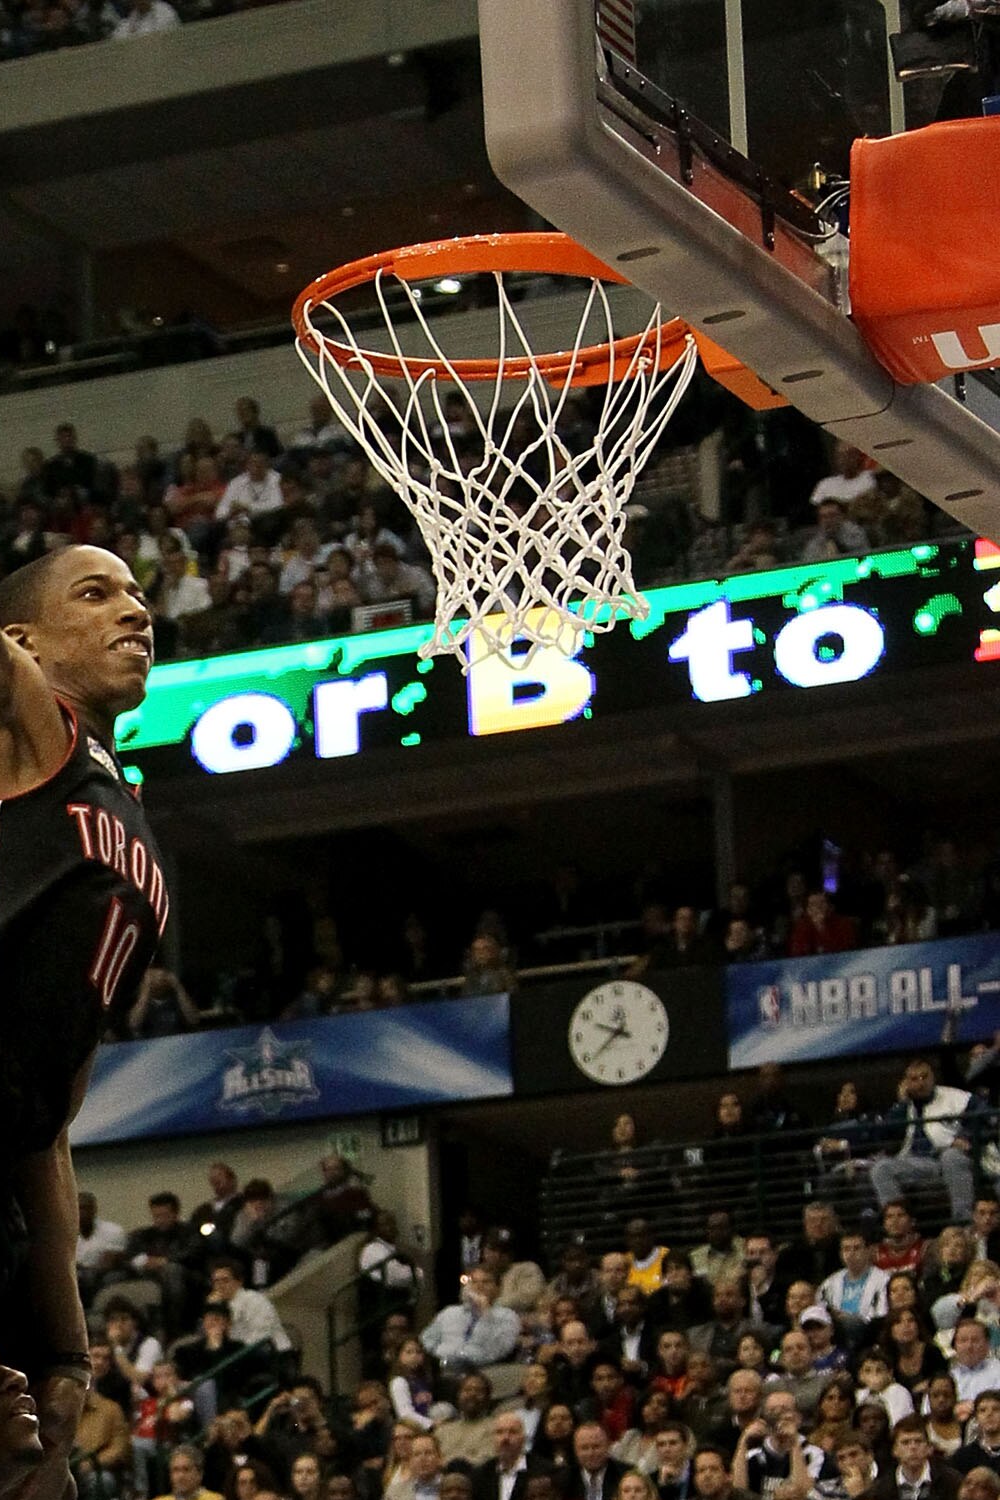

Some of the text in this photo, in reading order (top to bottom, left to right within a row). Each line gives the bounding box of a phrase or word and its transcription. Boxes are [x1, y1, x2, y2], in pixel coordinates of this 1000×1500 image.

[191, 671, 389, 774] or
[467, 605, 597, 737] B
[667, 597, 886, 704] to
[89, 896, 140, 1007] 10
[791, 974, 878, 1025] NBA
